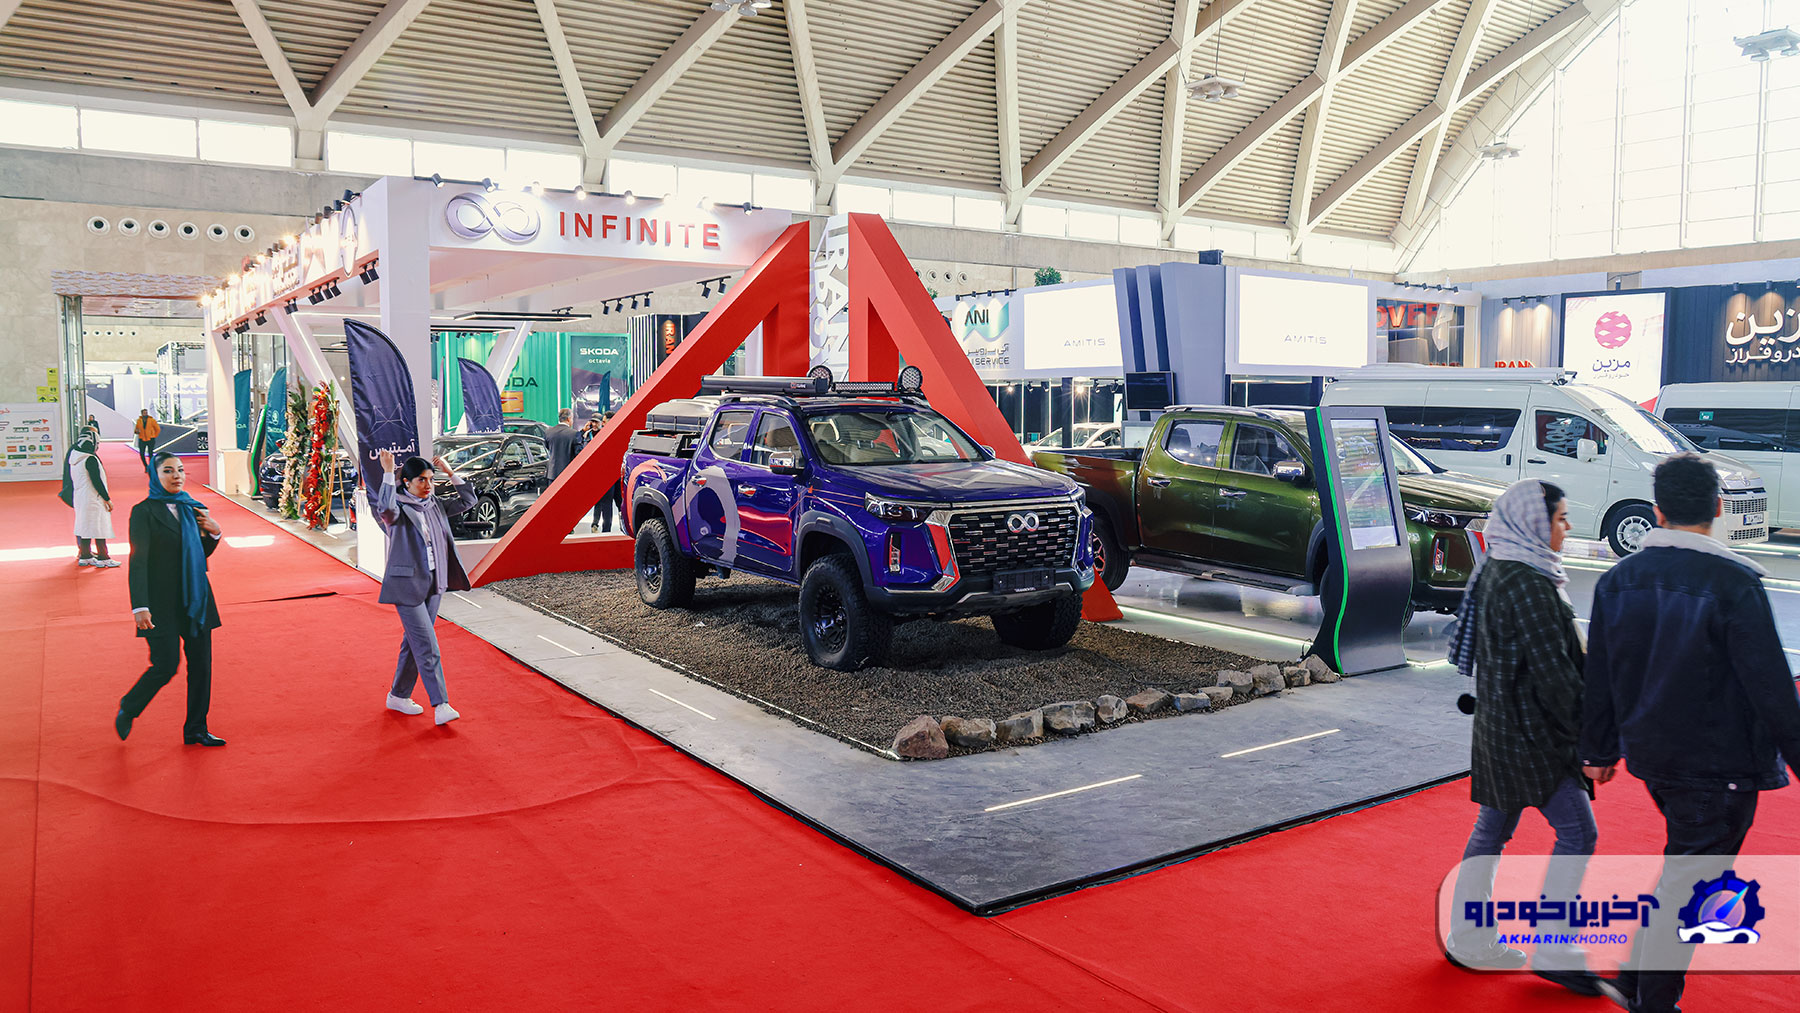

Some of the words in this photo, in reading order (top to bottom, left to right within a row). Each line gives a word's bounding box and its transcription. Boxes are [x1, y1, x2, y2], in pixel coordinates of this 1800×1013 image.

[559, 211, 720, 249] INFINITE
[964, 309, 989, 326] ANI
[1726, 308, 1800, 345] زین
[1063, 338, 1106, 347] AMITIS
[1283, 334, 1327, 344] AMITIS
[975, 357, 1010, 366] SERVICE
[1592, 359, 1630, 373] مزین
